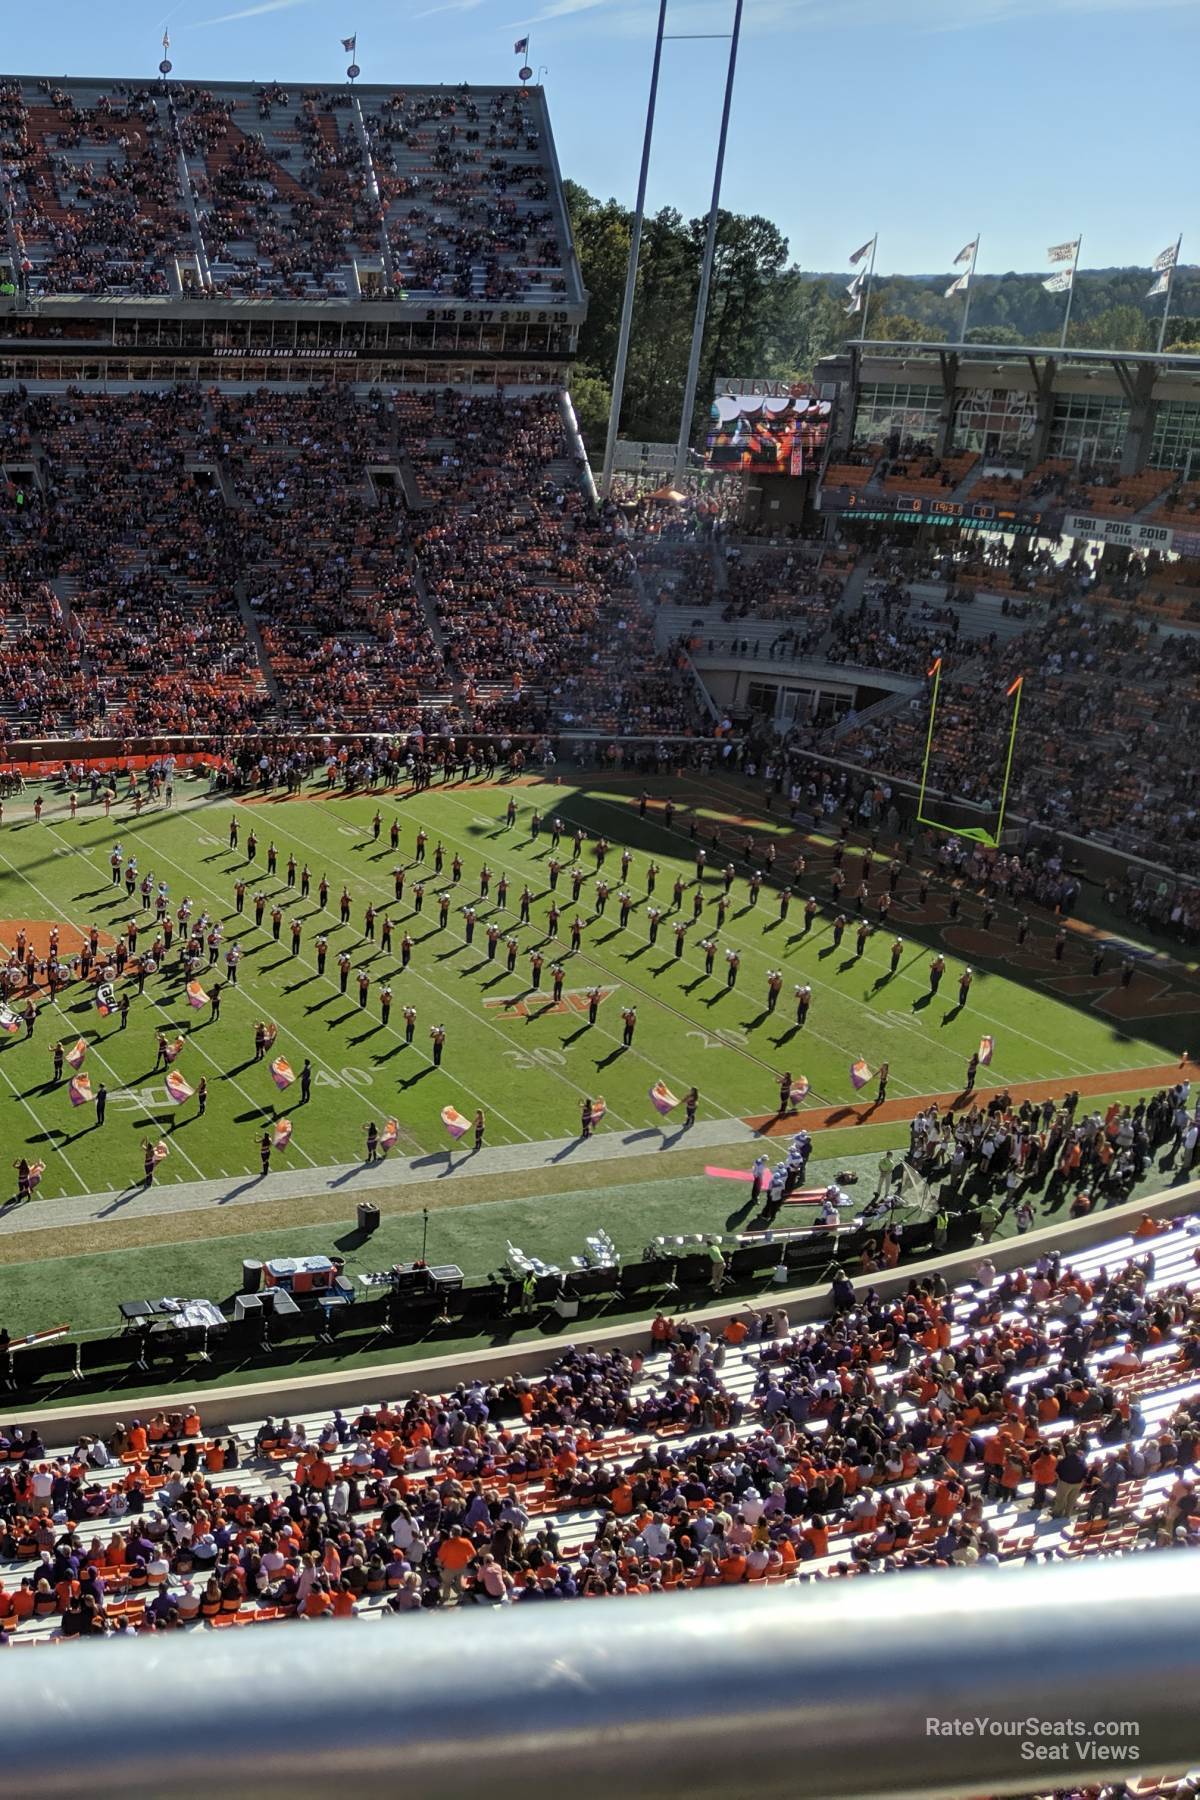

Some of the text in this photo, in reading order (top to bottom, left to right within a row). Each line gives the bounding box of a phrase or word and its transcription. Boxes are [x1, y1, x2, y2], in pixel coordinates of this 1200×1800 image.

[213, 348, 247, 357] SUPPORT
[250, 349, 271, 357] TIGER
[274, 349, 293, 357] BAND
[296, 350, 330, 358] THROUGH
[842, 511, 887, 521] SUPPORT
[893, 513, 922, 524] TIGER
[926, 515, 954, 527] BAND
[958, 518, 1004, 532] THROUGH
[1073, 518, 1168, 541] 1981 2016 2018
[503, 1048, 567, 1069] 30
[314, 1067, 373, 1089] 40
